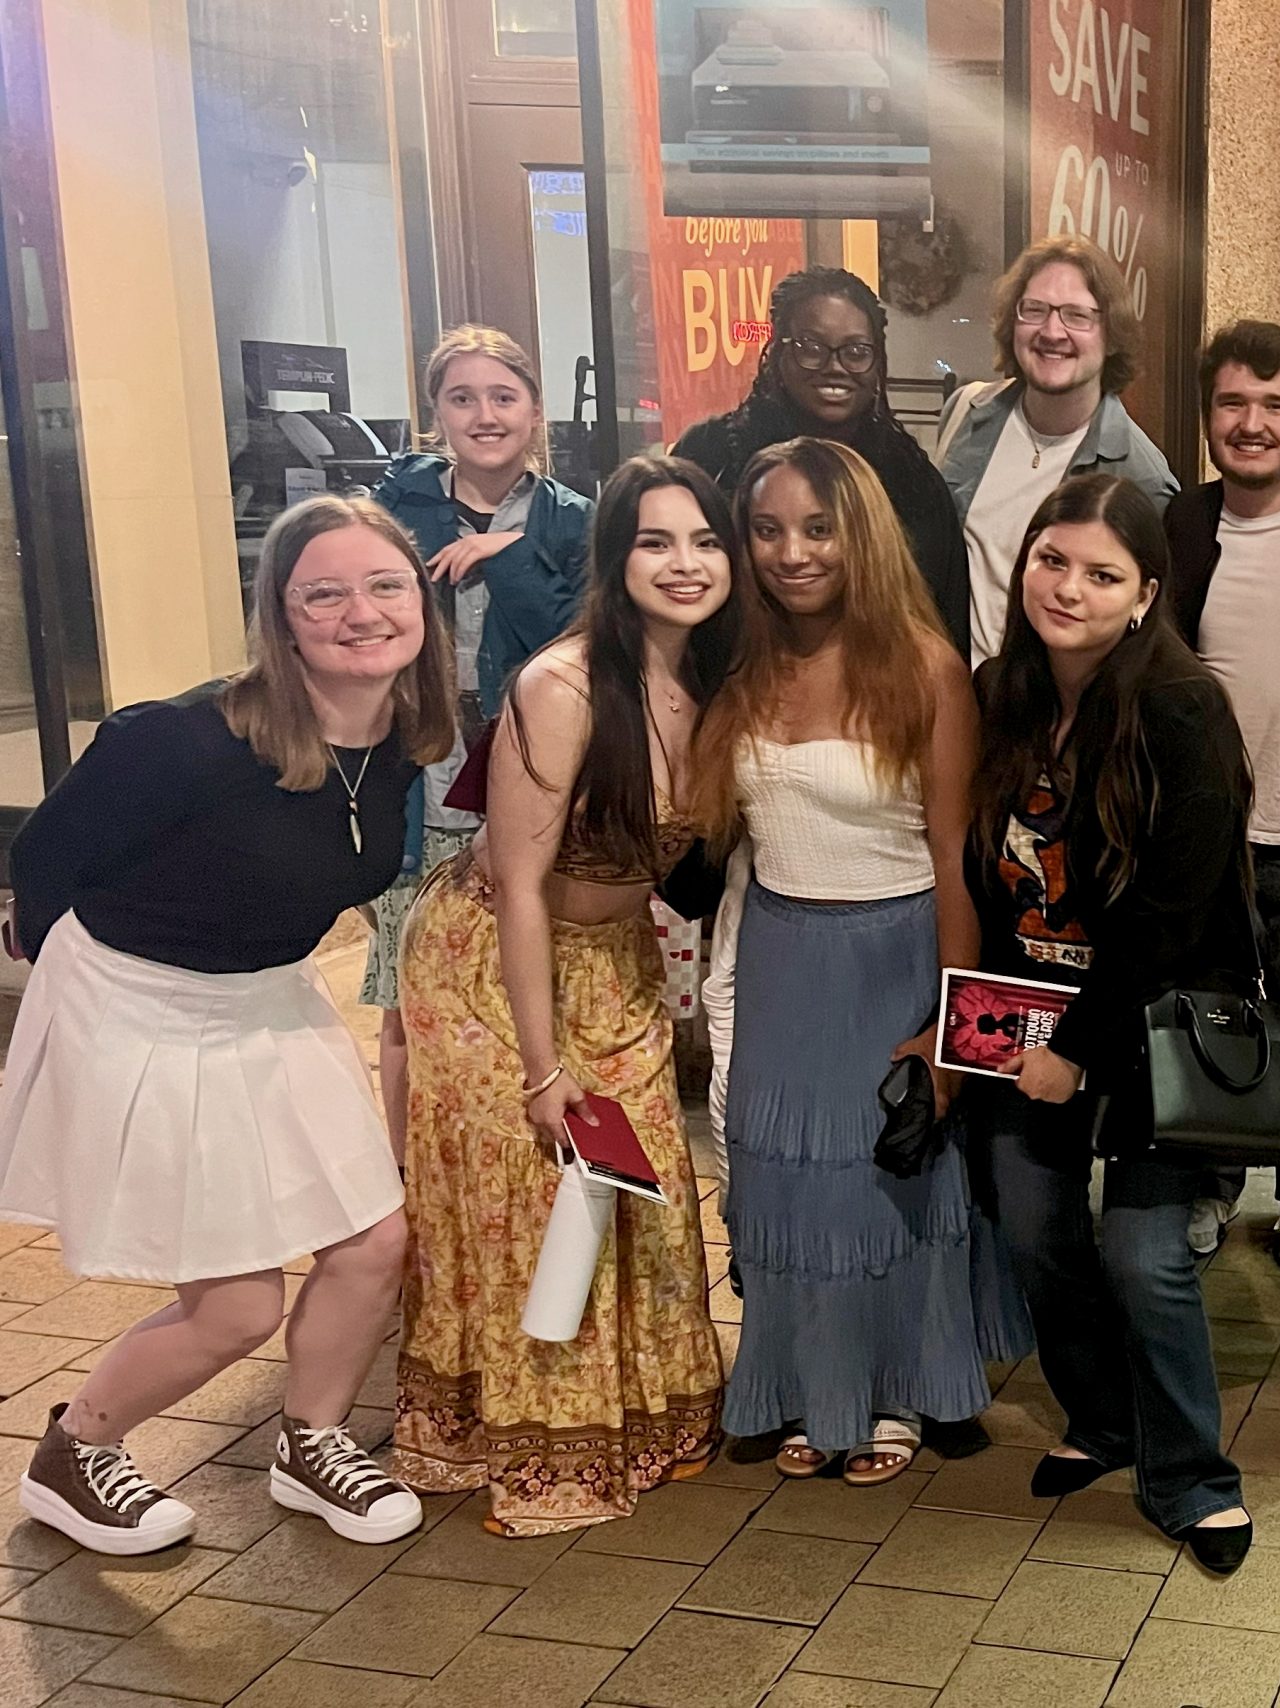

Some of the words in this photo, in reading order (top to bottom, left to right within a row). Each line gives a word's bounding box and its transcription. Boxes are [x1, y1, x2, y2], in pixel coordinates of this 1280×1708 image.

[1049, 0, 1151, 136] SAVE
[1115, 151, 1131, 178] UP
[1135, 159, 1149, 186] TO
[685, 216, 742, 258] before
[742, 218, 769, 256] you
[683, 265, 773, 373] BUY
